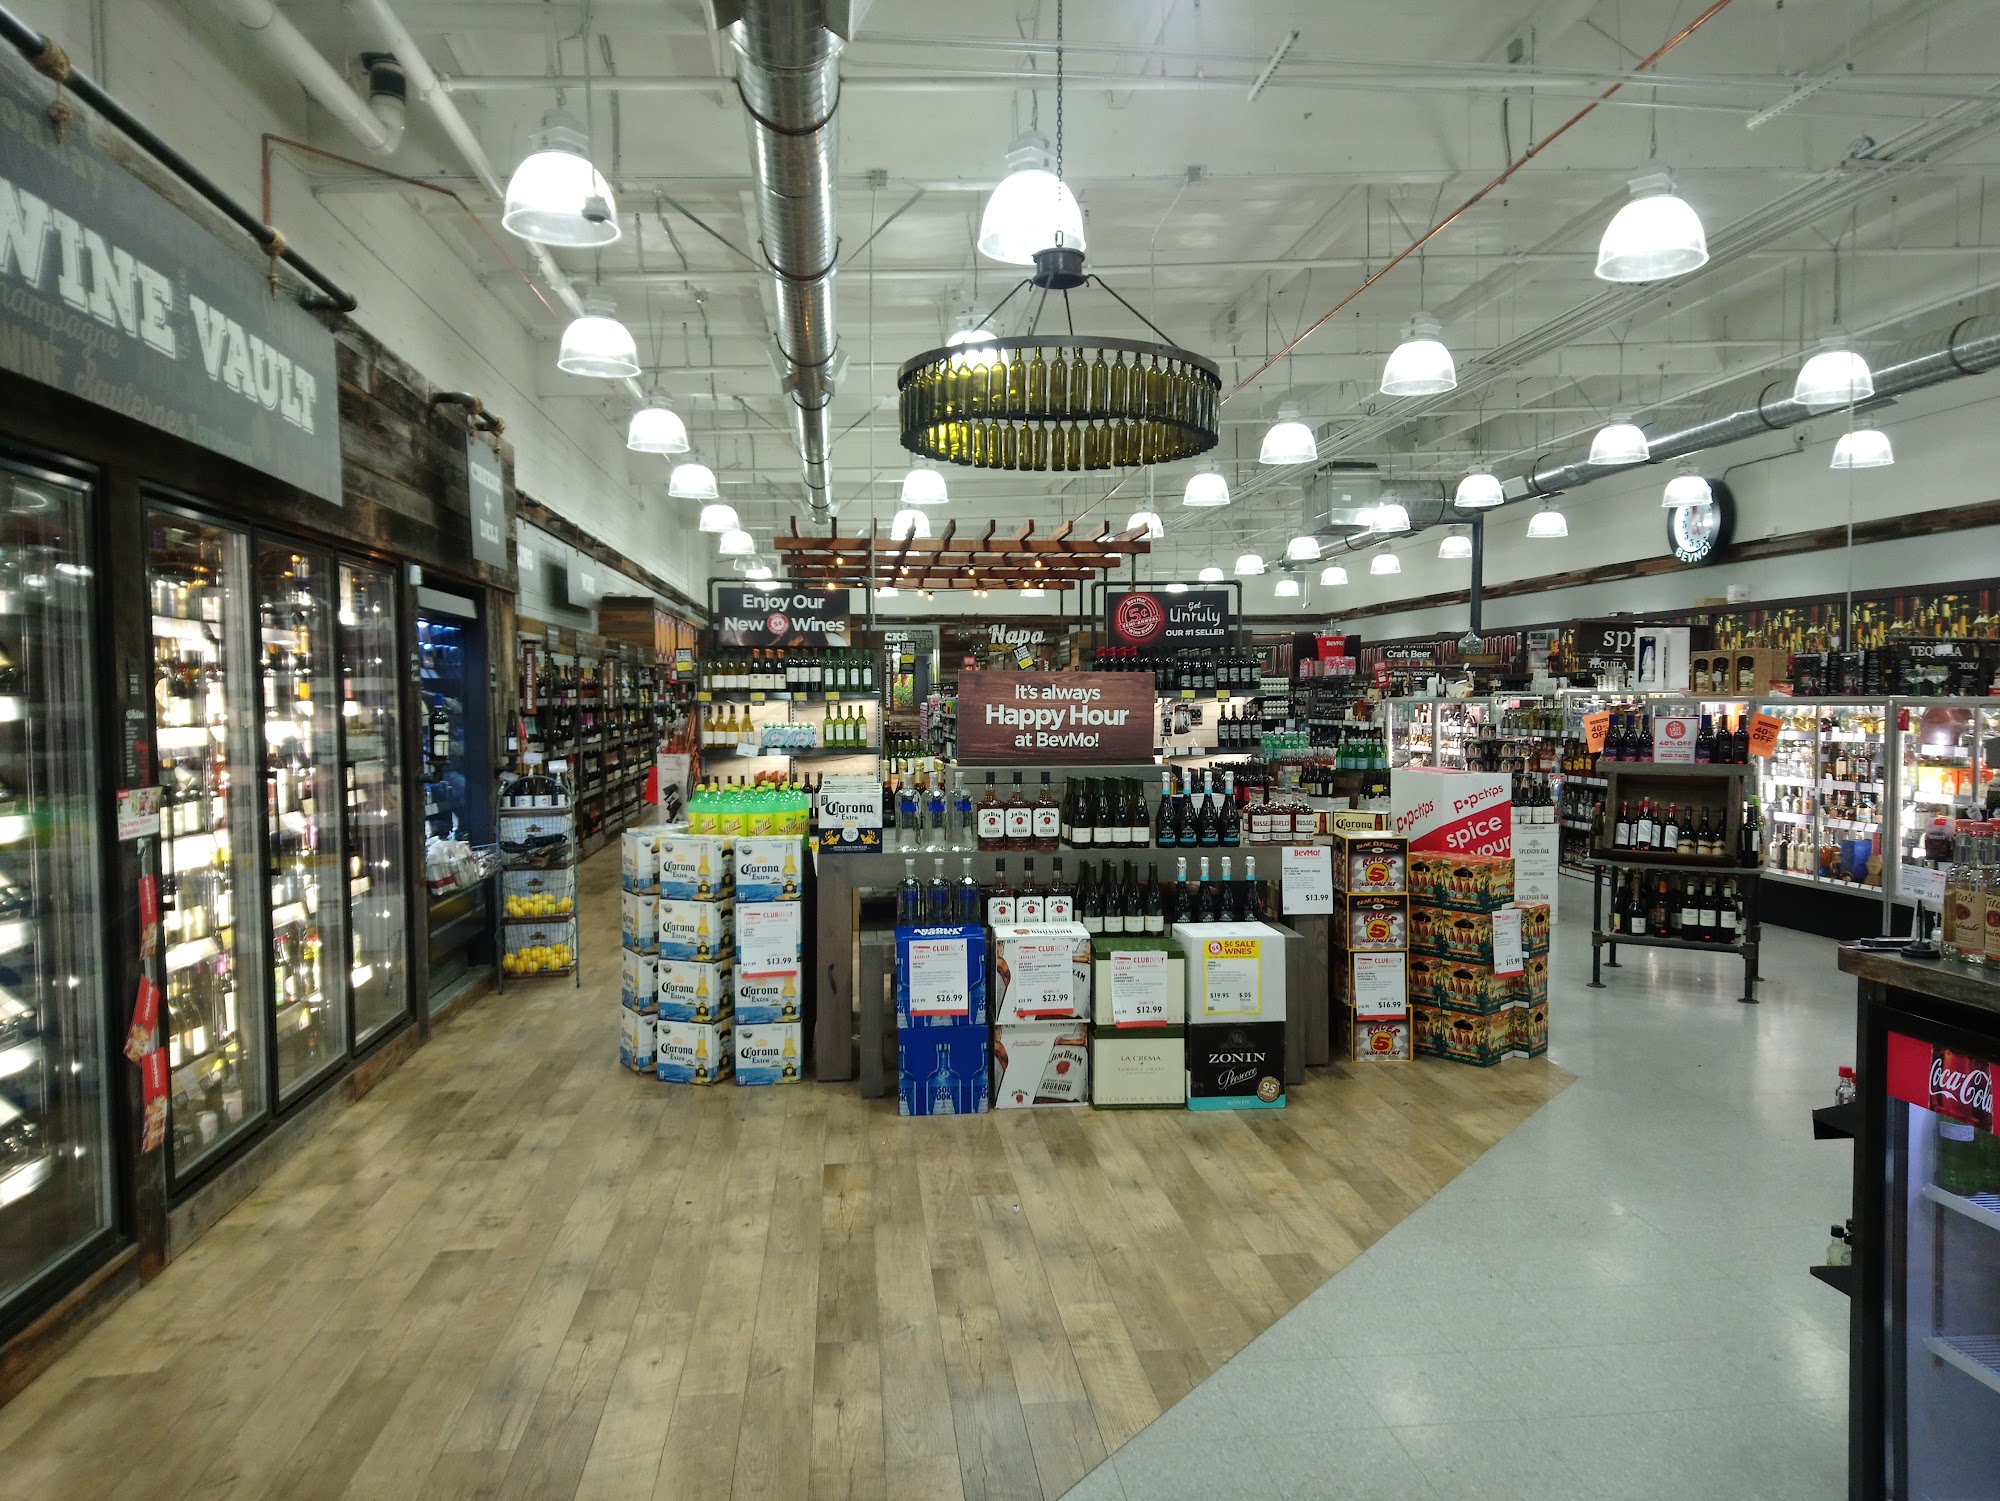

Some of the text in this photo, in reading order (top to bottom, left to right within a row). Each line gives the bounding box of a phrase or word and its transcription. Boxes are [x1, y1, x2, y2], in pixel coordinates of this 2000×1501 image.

[0, 177, 177, 360] WINE
[189, 294, 316, 436] VAULT
[1675, 541, 1712, 562] BEVMO!
[742, 594, 825, 613] Enjoy Our
[1188, 601, 1201, 611] Get
[1170, 607, 1221, 627] Unruly
[724, 617, 845, 632] New Wines
[988, 624, 1046, 648] Napa
[1165, 629, 1184, 637] OUR
[1195, 628, 1225, 636] SELLER
[1387, 649, 1431, 658] Craft Beer
[1909, 645, 1963, 659] TEQUA
[1015, 684, 1100, 703] It's always
[985, 703, 1129, 730] Happy Hour
[1752, 732, 1773, 744] OFF
[1754, 726, 1775, 737] 40%
[1015, 732, 1100, 748] at BevMo!
[1453, 784, 1504, 814] popchips
[825, 801, 874, 818] Corona
[1396, 800, 1434, 834] popchips
[1335, 818, 1373, 830] Corona
[1446, 816, 1503, 849] spice
[1373, 841, 1400, 849] REPUBLIC
[1469, 835, 1511, 856] your
[1294, 849, 1321, 857] BevMo!
[663, 860, 695, 873] Corona
[1362, 855, 1397, 868] RACER
[740, 863, 779, 876] Corona
[1368, 867, 1386, 882] 5
[1305, 894, 1329, 902] $13.99
[1373, 897, 1400, 906] REPUBLIC
[1363, 912, 1398, 925] RACER
[662, 921, 695, 933] Corona
[1369, 923, 1387, 938] 5
[1234, 940, 1256, 948] SALE
[1224, 947, 1252, 955] WINES
[766, 957, 792, 965] $13.99
[1133, 956, 1164, 964] CLUBBEV!
[1505, 957, 1520, 966] $15.99
[1072, 969, 1086, 982] EAM
[661, 981, 694, 994] Corona
[740, 985, 779, 999] Corona
[936, 994, 963, 1003] $26.99
[1042, 994, 1069, 1003] $22.99
[1137, 1006, 1163, 1014] $12.99
[1367, 1023, 1401, 1037] RACER
[660, 1043, 693, 1055] Corona
[1373, 1036, 1391, 1050] 5
[740, 1046, 779, 1060] Corona
[1048, 1050, 1083, 1066] JIM BEAM
[1208, 1052, 1267, 1064] ZONIN
[1217, 1066, 1258, 1091] Prosecco
[1041, 1082, 1072, 1092] BOURBON
[1262, 1082, 1277, 1094] 95
[1928, 1057, 1993, 1114] Coca-Cola
